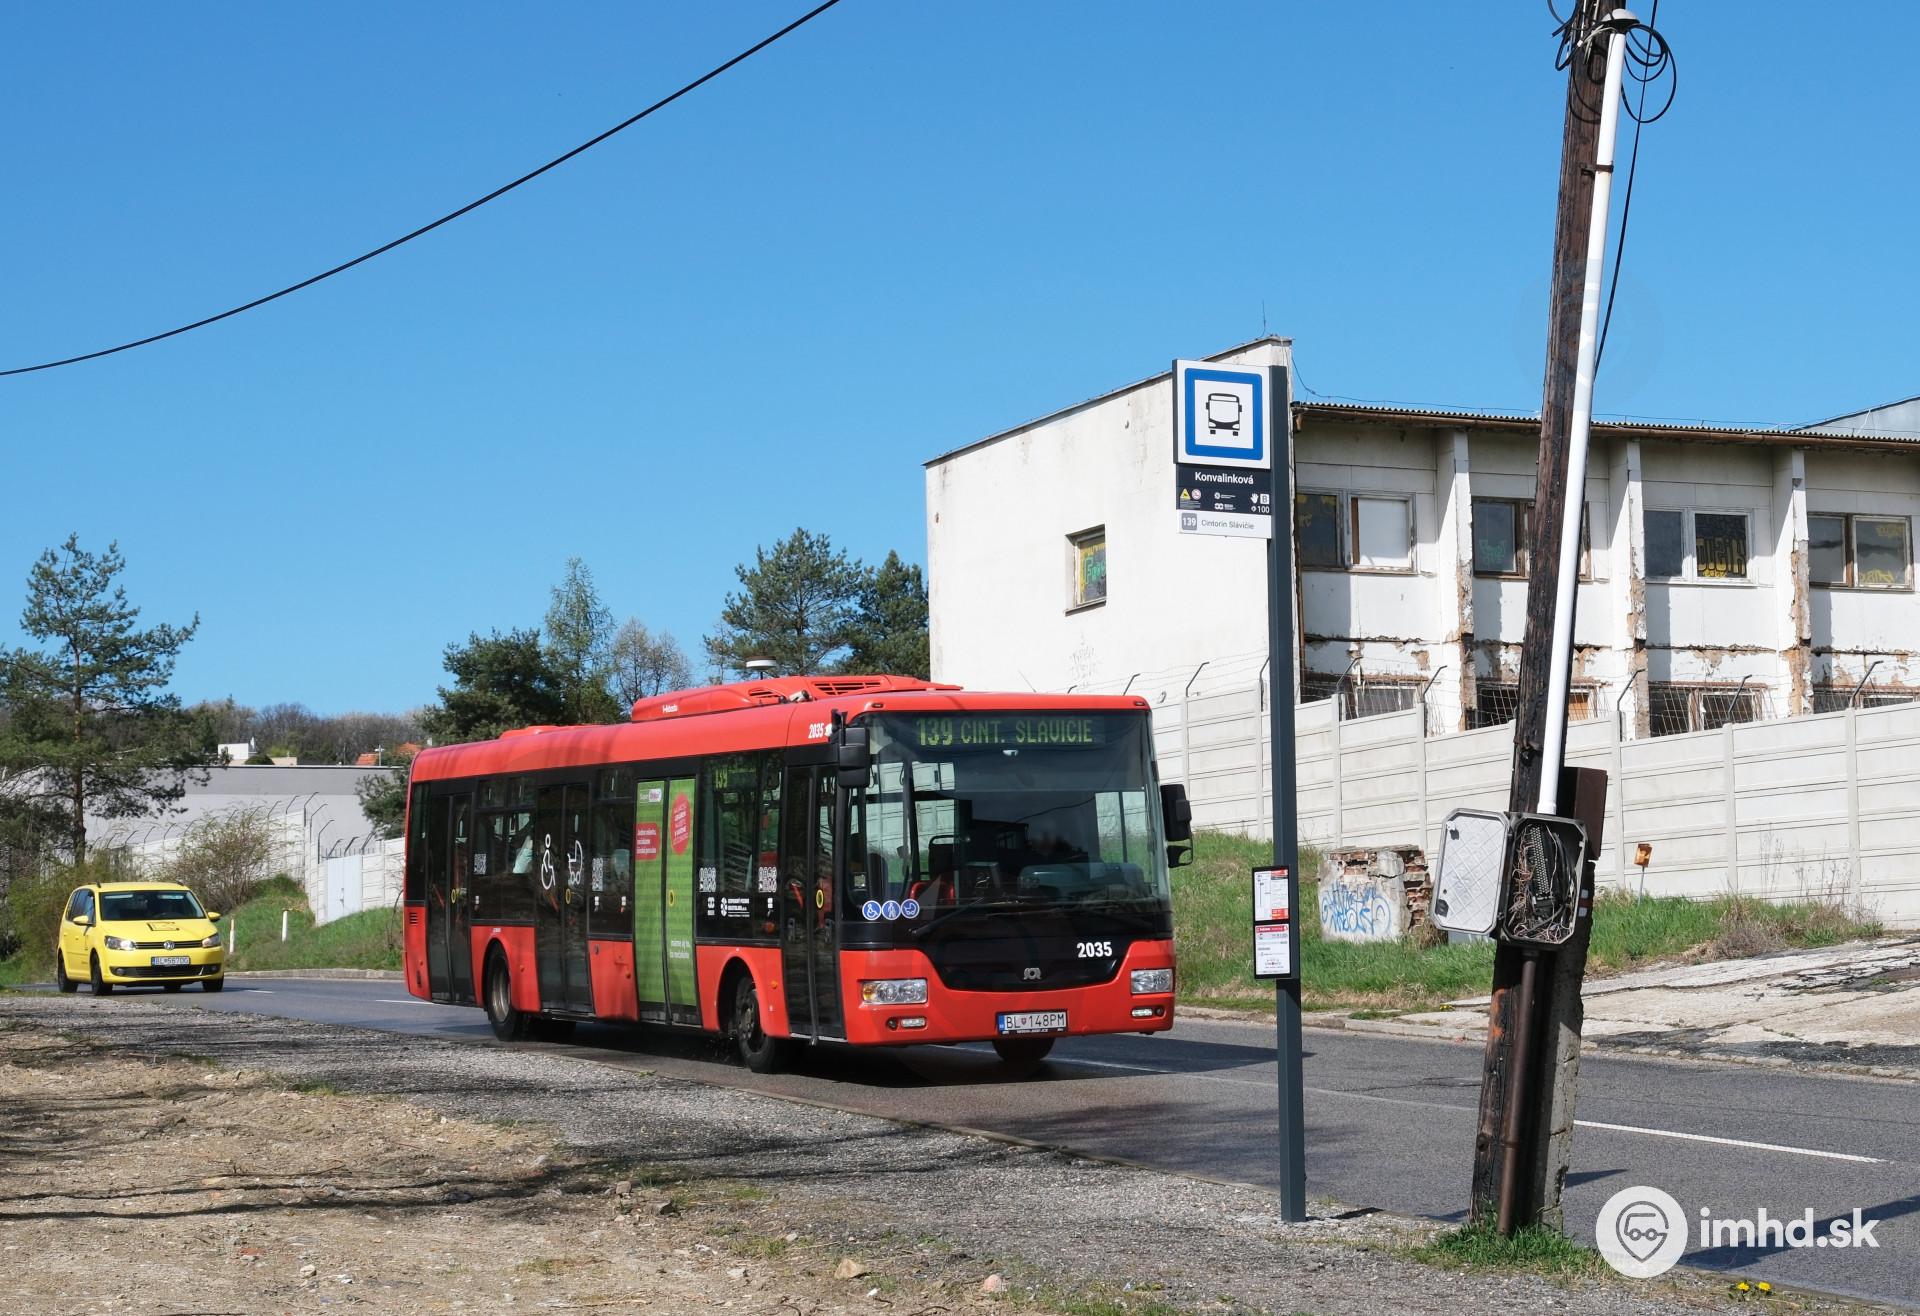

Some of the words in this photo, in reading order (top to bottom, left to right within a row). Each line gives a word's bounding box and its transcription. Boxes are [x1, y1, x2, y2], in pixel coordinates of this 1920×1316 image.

[1195, 472, 1254, 484] Konvalinková
[1257, 505, 1270, 513] 100
[1183, 517, 1197, 527] 139
[808, 722, 825, 739] 2035
[917, 718, 953, 746] 139
[961, 720, 1005, 743] CINT.
[1076, 941, 1113, 958] 2035
